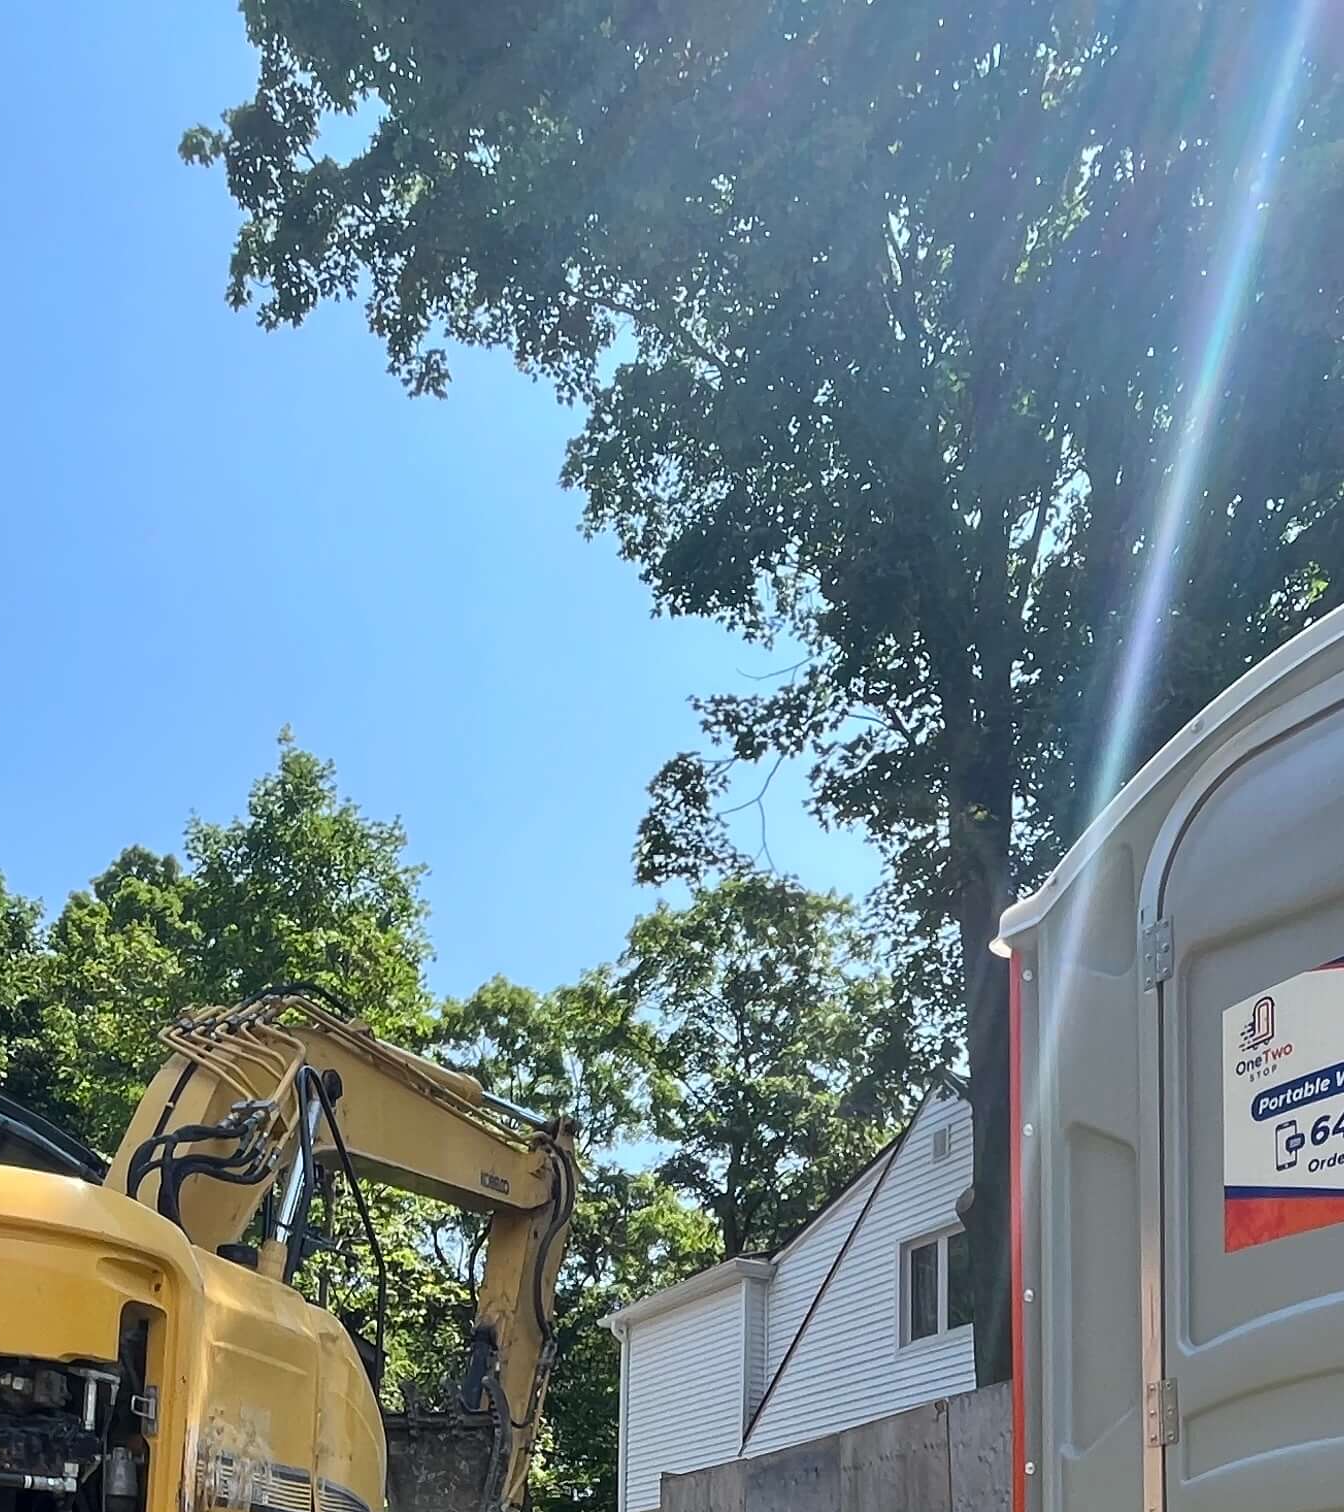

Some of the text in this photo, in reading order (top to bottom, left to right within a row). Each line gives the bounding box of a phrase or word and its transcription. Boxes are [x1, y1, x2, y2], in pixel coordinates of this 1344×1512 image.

[1236, 1043, 1293, 1076] OneTwo
[1249, 1065, 1277, 1082] STOP
[1258, 1078, 1330, 1115] Portable
